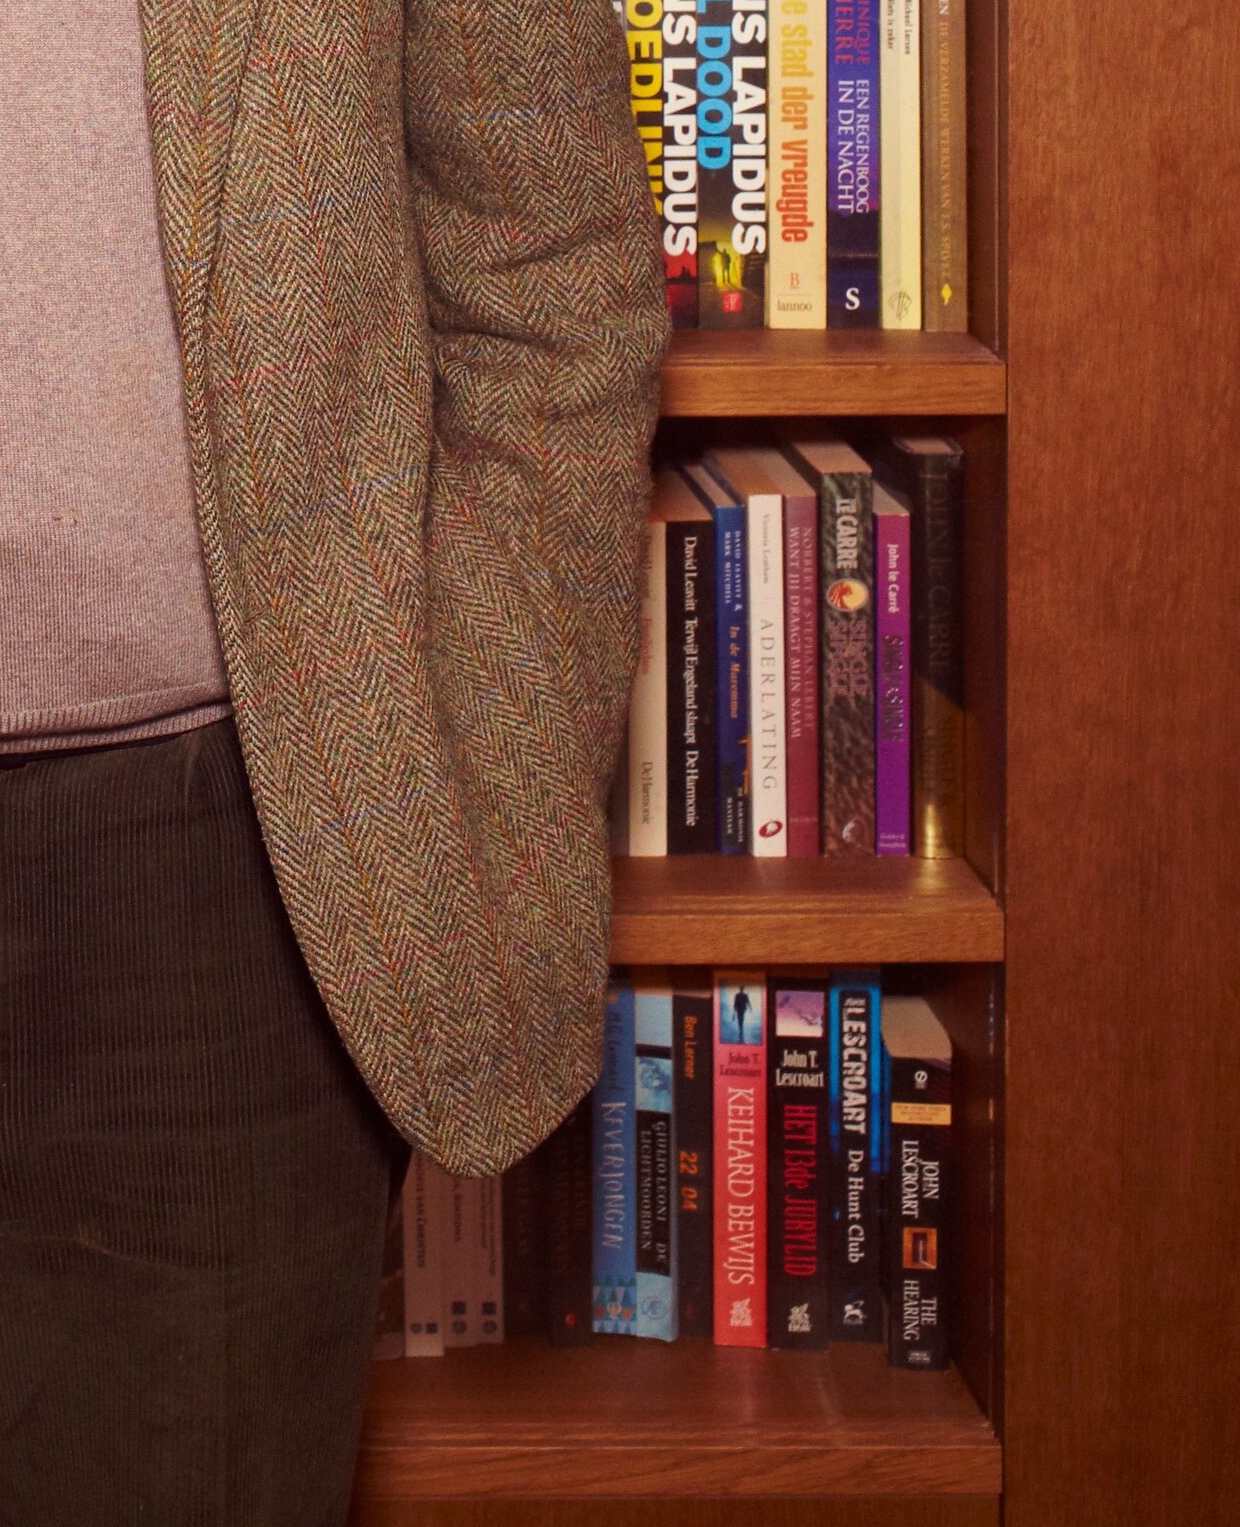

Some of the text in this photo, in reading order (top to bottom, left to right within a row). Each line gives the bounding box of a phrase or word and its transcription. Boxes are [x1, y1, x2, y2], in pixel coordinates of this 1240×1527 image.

[696, 25, 732, 170] DOOD
[781, 23, 814, 77] stad
[781, 85, 814, 130] der
[663, 57, 699, 257] LAPIDUS
[732, 56, 767, 256] LAPIDUS
[776, 138, 815, 242] vreugde
[837, 79, 856, 215] IN DE NACHT
[855, 78, 870, 214] EEN REGENBOOG
[682, 535, 700, 827] David Leavitt Terwijl Engeland slaapt De Harmonie
[758, 618, 778, 791] ADERLATING
[679, 1150, 699, 1211] 22 04
[726, 1086, 756, 1286] KEIHARD BEWIJS
[784, 1104, 818, 1276] HET 13de JURYLID
[843, 1008, 868, 1263] LESCROART De Hunt Club
[902, 1139, 921, 1218] LESCROART
[922, 1160, 940, 1199] JOHN
[902, 1279, 922, 1341] HEARING
[922, 1296, 938, 1325] THE
